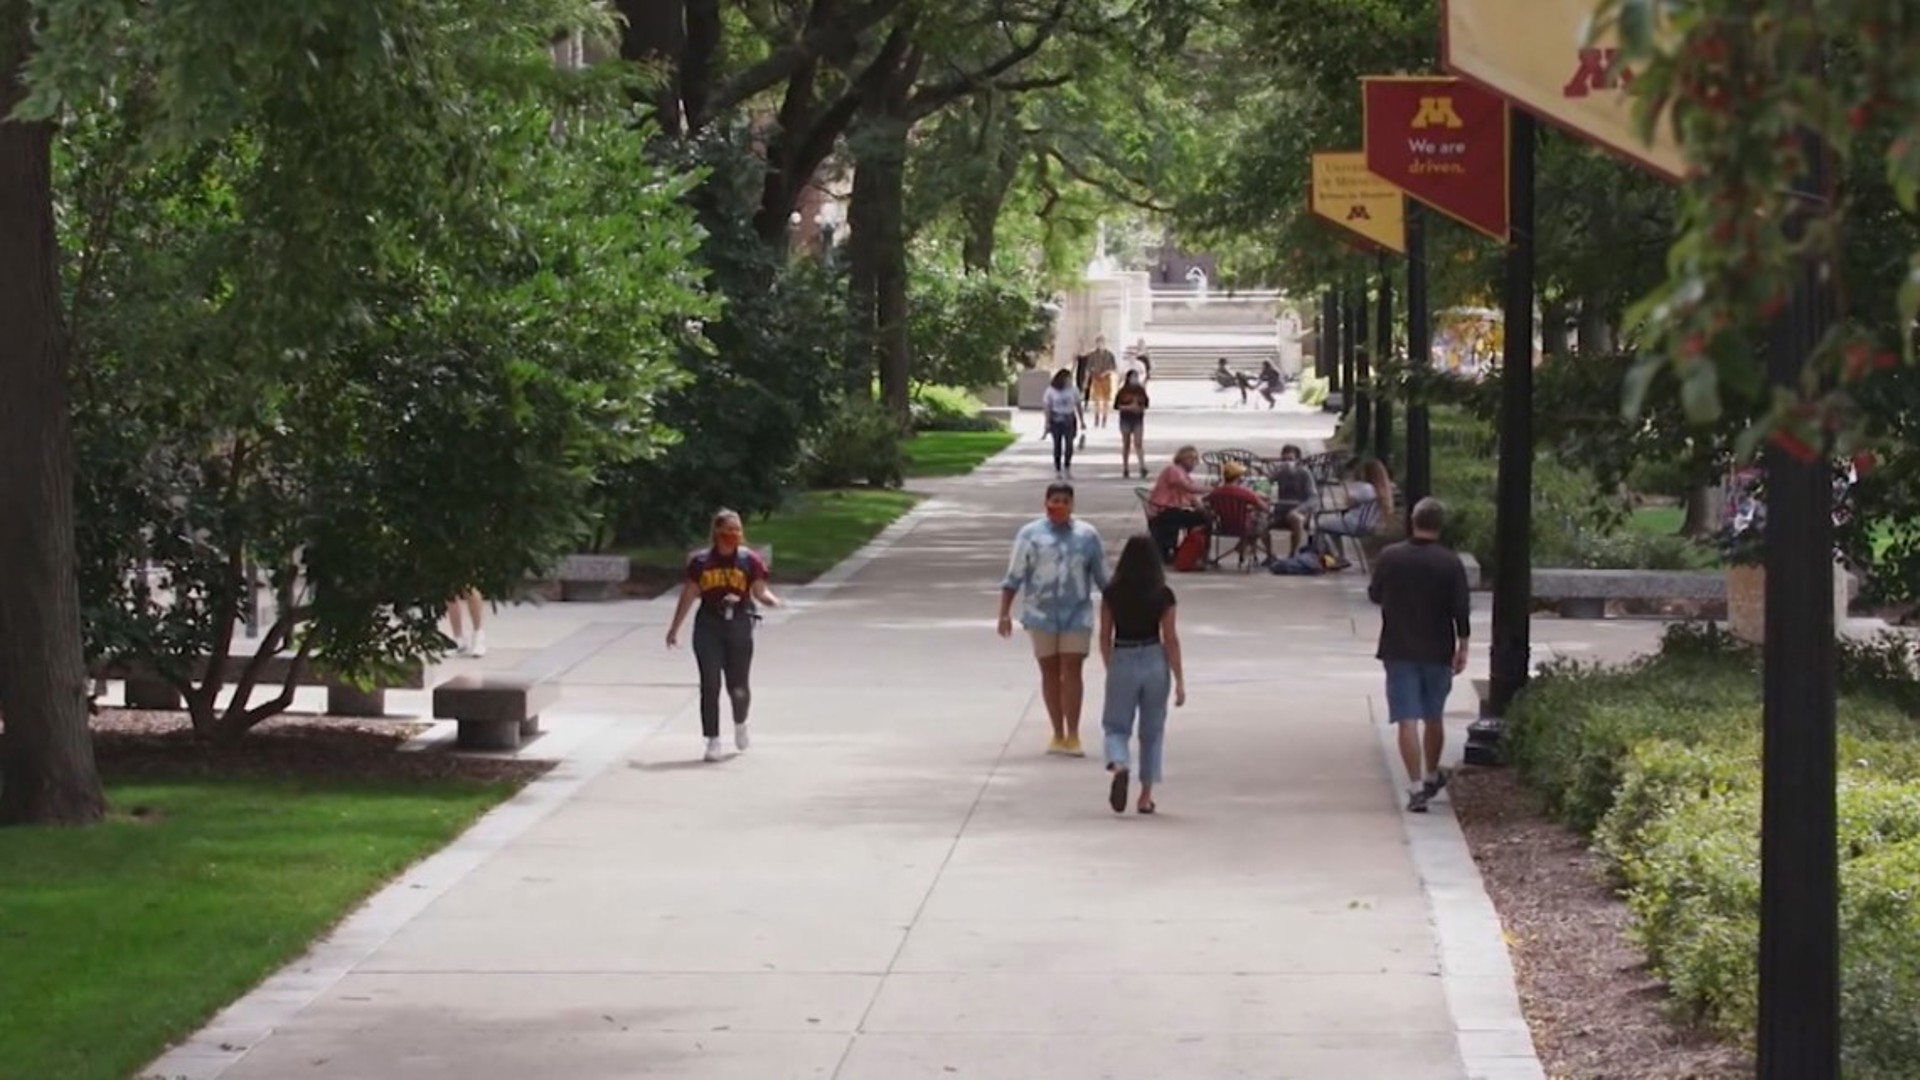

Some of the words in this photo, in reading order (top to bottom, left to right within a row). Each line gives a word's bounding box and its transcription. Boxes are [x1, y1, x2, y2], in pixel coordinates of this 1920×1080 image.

[1410, 96, 1463, 128] M
[1408, 138, 1435, 154] We
[1438, 142, 1465, 154] are
[1408, 159, 1465, 174] driven.
[1346, 205, 1371, 221] M
